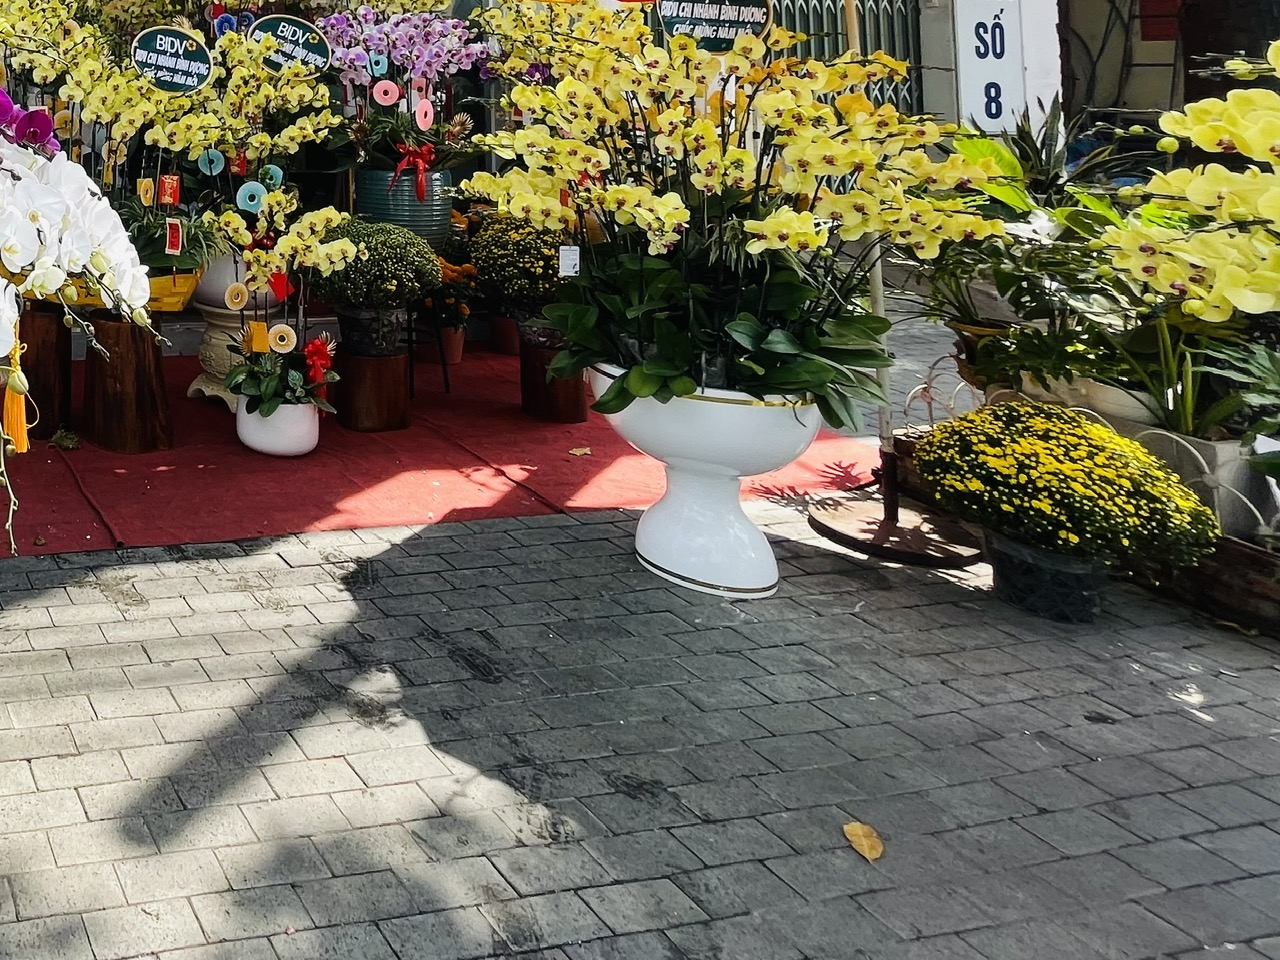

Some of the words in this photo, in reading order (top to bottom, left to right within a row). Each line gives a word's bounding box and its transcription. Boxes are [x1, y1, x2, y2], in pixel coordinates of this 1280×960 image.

[661, 0, 679, 17] BIDV
[679, 5, 693, 18] CHI
[720, 0, 741, 21] BÌNH
[739, 5, 767, 23] DƯƠNG
[156, 34, 187, 55] BIDV
[277, 22, 311, 44] BIDV
[974, 8, 1005, 60] SỐ
[984, 81, 1003, 120] 8
